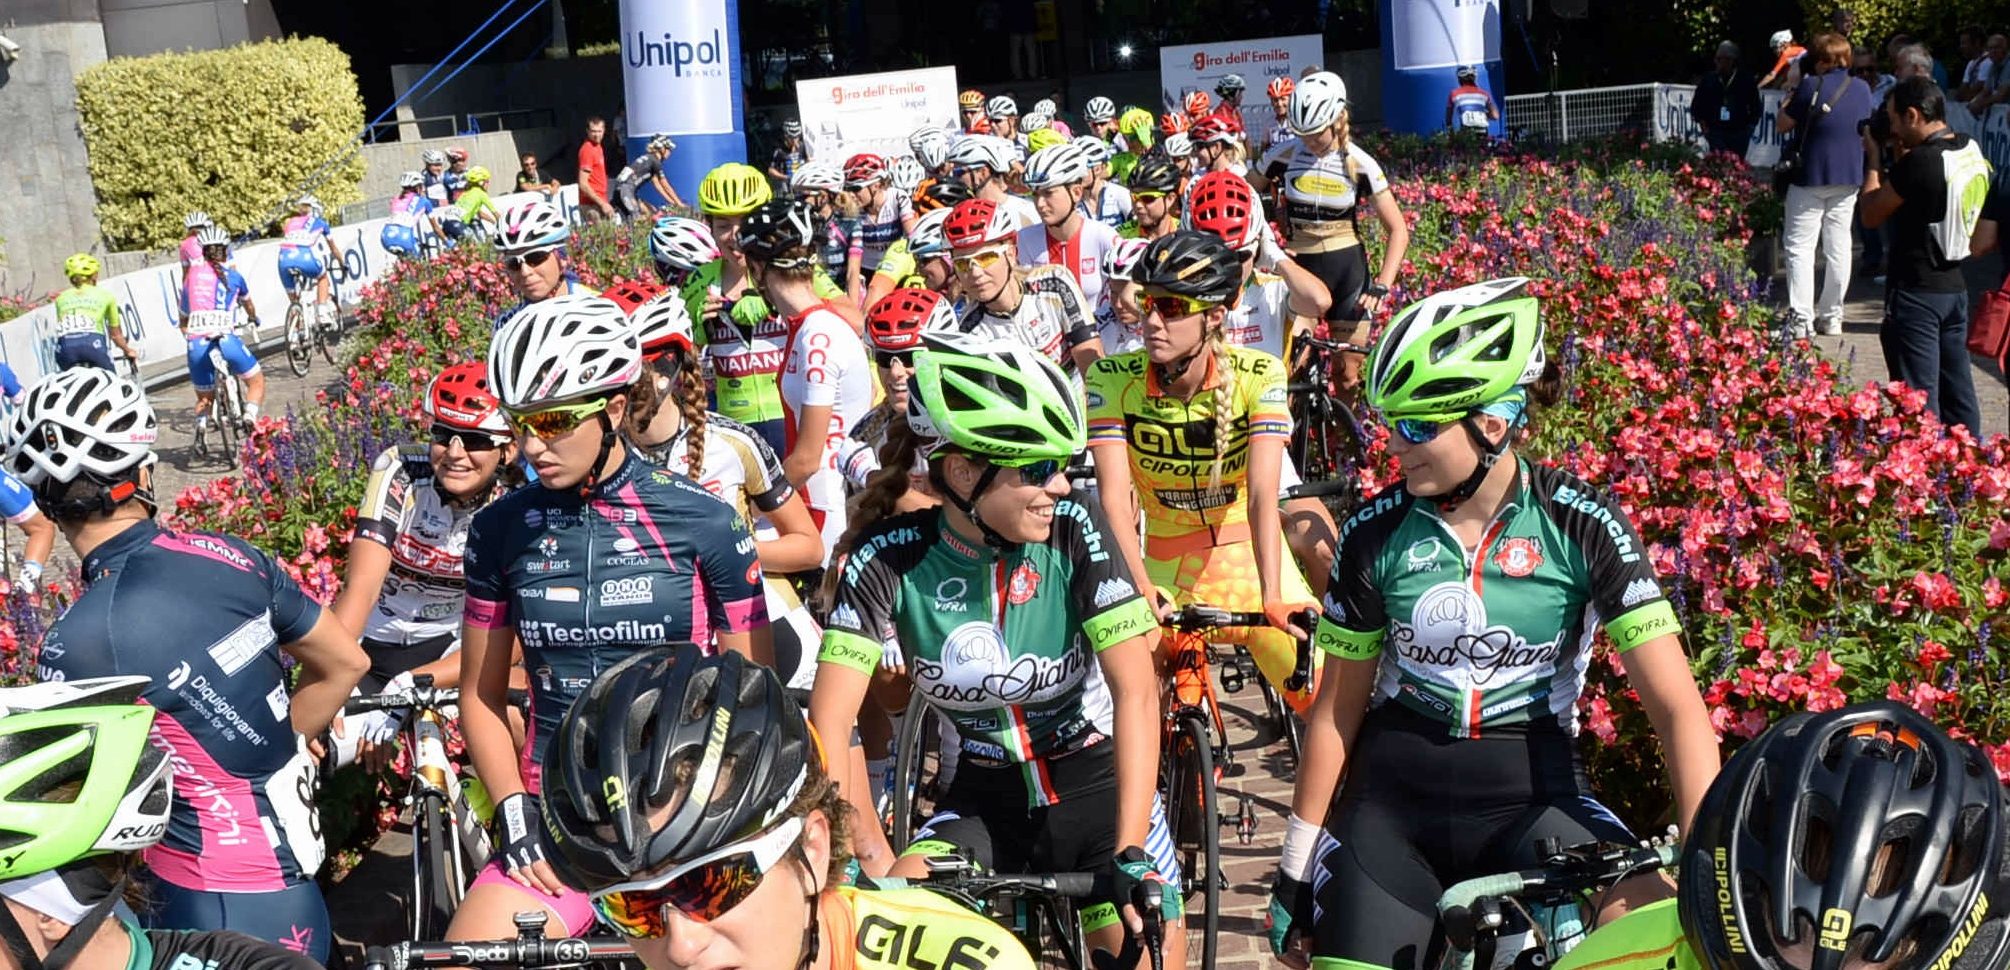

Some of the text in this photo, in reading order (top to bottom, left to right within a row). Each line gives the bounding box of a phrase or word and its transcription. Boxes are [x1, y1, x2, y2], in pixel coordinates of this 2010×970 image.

[627, 29, 721, 77] Unipol
[1263, 64, 1291, 76] Unipol
[901, 97, 927, 109] Unipol
[806, 333, 831, 384] CCC
[1429, 388, 1488, 409] RUDY
[971, 439, 1033, 455] RUDY
[1054, 498, 1110, 563] anchi
[1552, 485, 1641, 564] Bianchi
[1407, 561, 1442, 573] VIFRA
[934, 601, 968, 612] VIFRA
[541, 619, 666, 642] Tecnofilm
[1392, 621, 1458, 667] Casa
[914, 657, 986, 703] Casa
[190, 674, 264, 747] Diquigiovanni
[211, 714, 226, 733] for
[221, 725, 236, 742] life
[112, 822, 165, 841] RUD
[452, 943, 585, 964] Deda 35
